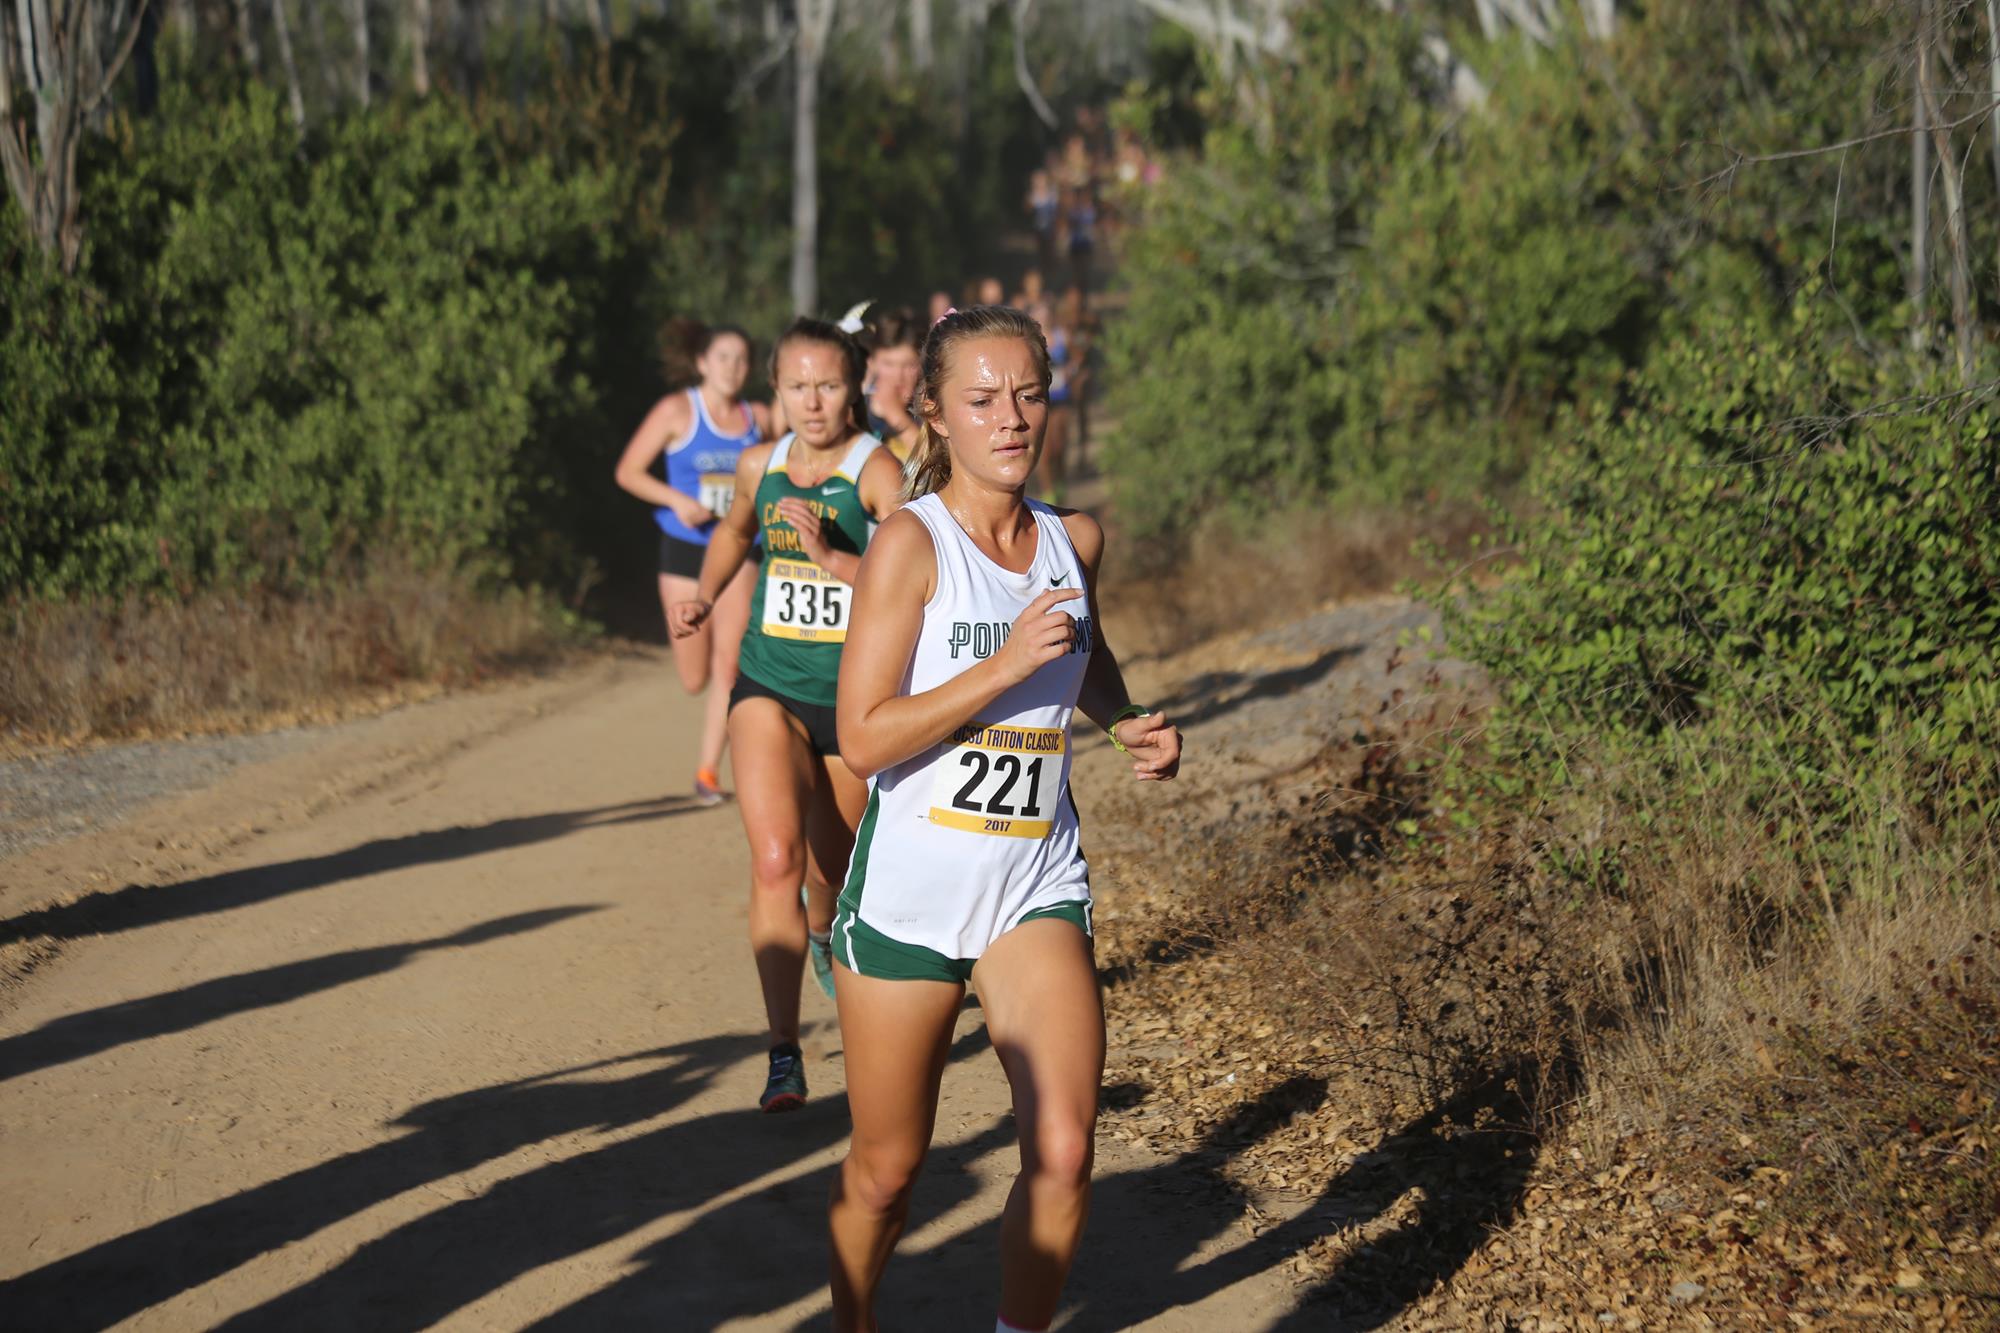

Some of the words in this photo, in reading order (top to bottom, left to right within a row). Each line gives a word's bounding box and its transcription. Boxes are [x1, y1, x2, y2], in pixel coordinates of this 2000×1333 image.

[768, 529, 807, 552] POM
[779, 582, 841, 626] 335
[953, 725, 984, 745] UCSD
[986, 729, 1024, 749] TRITON
[1025, 732, 1060, 751] CLASSIC
[952, 750, 1043, 817] 221
[984, 819, 1011, 832] 2017
